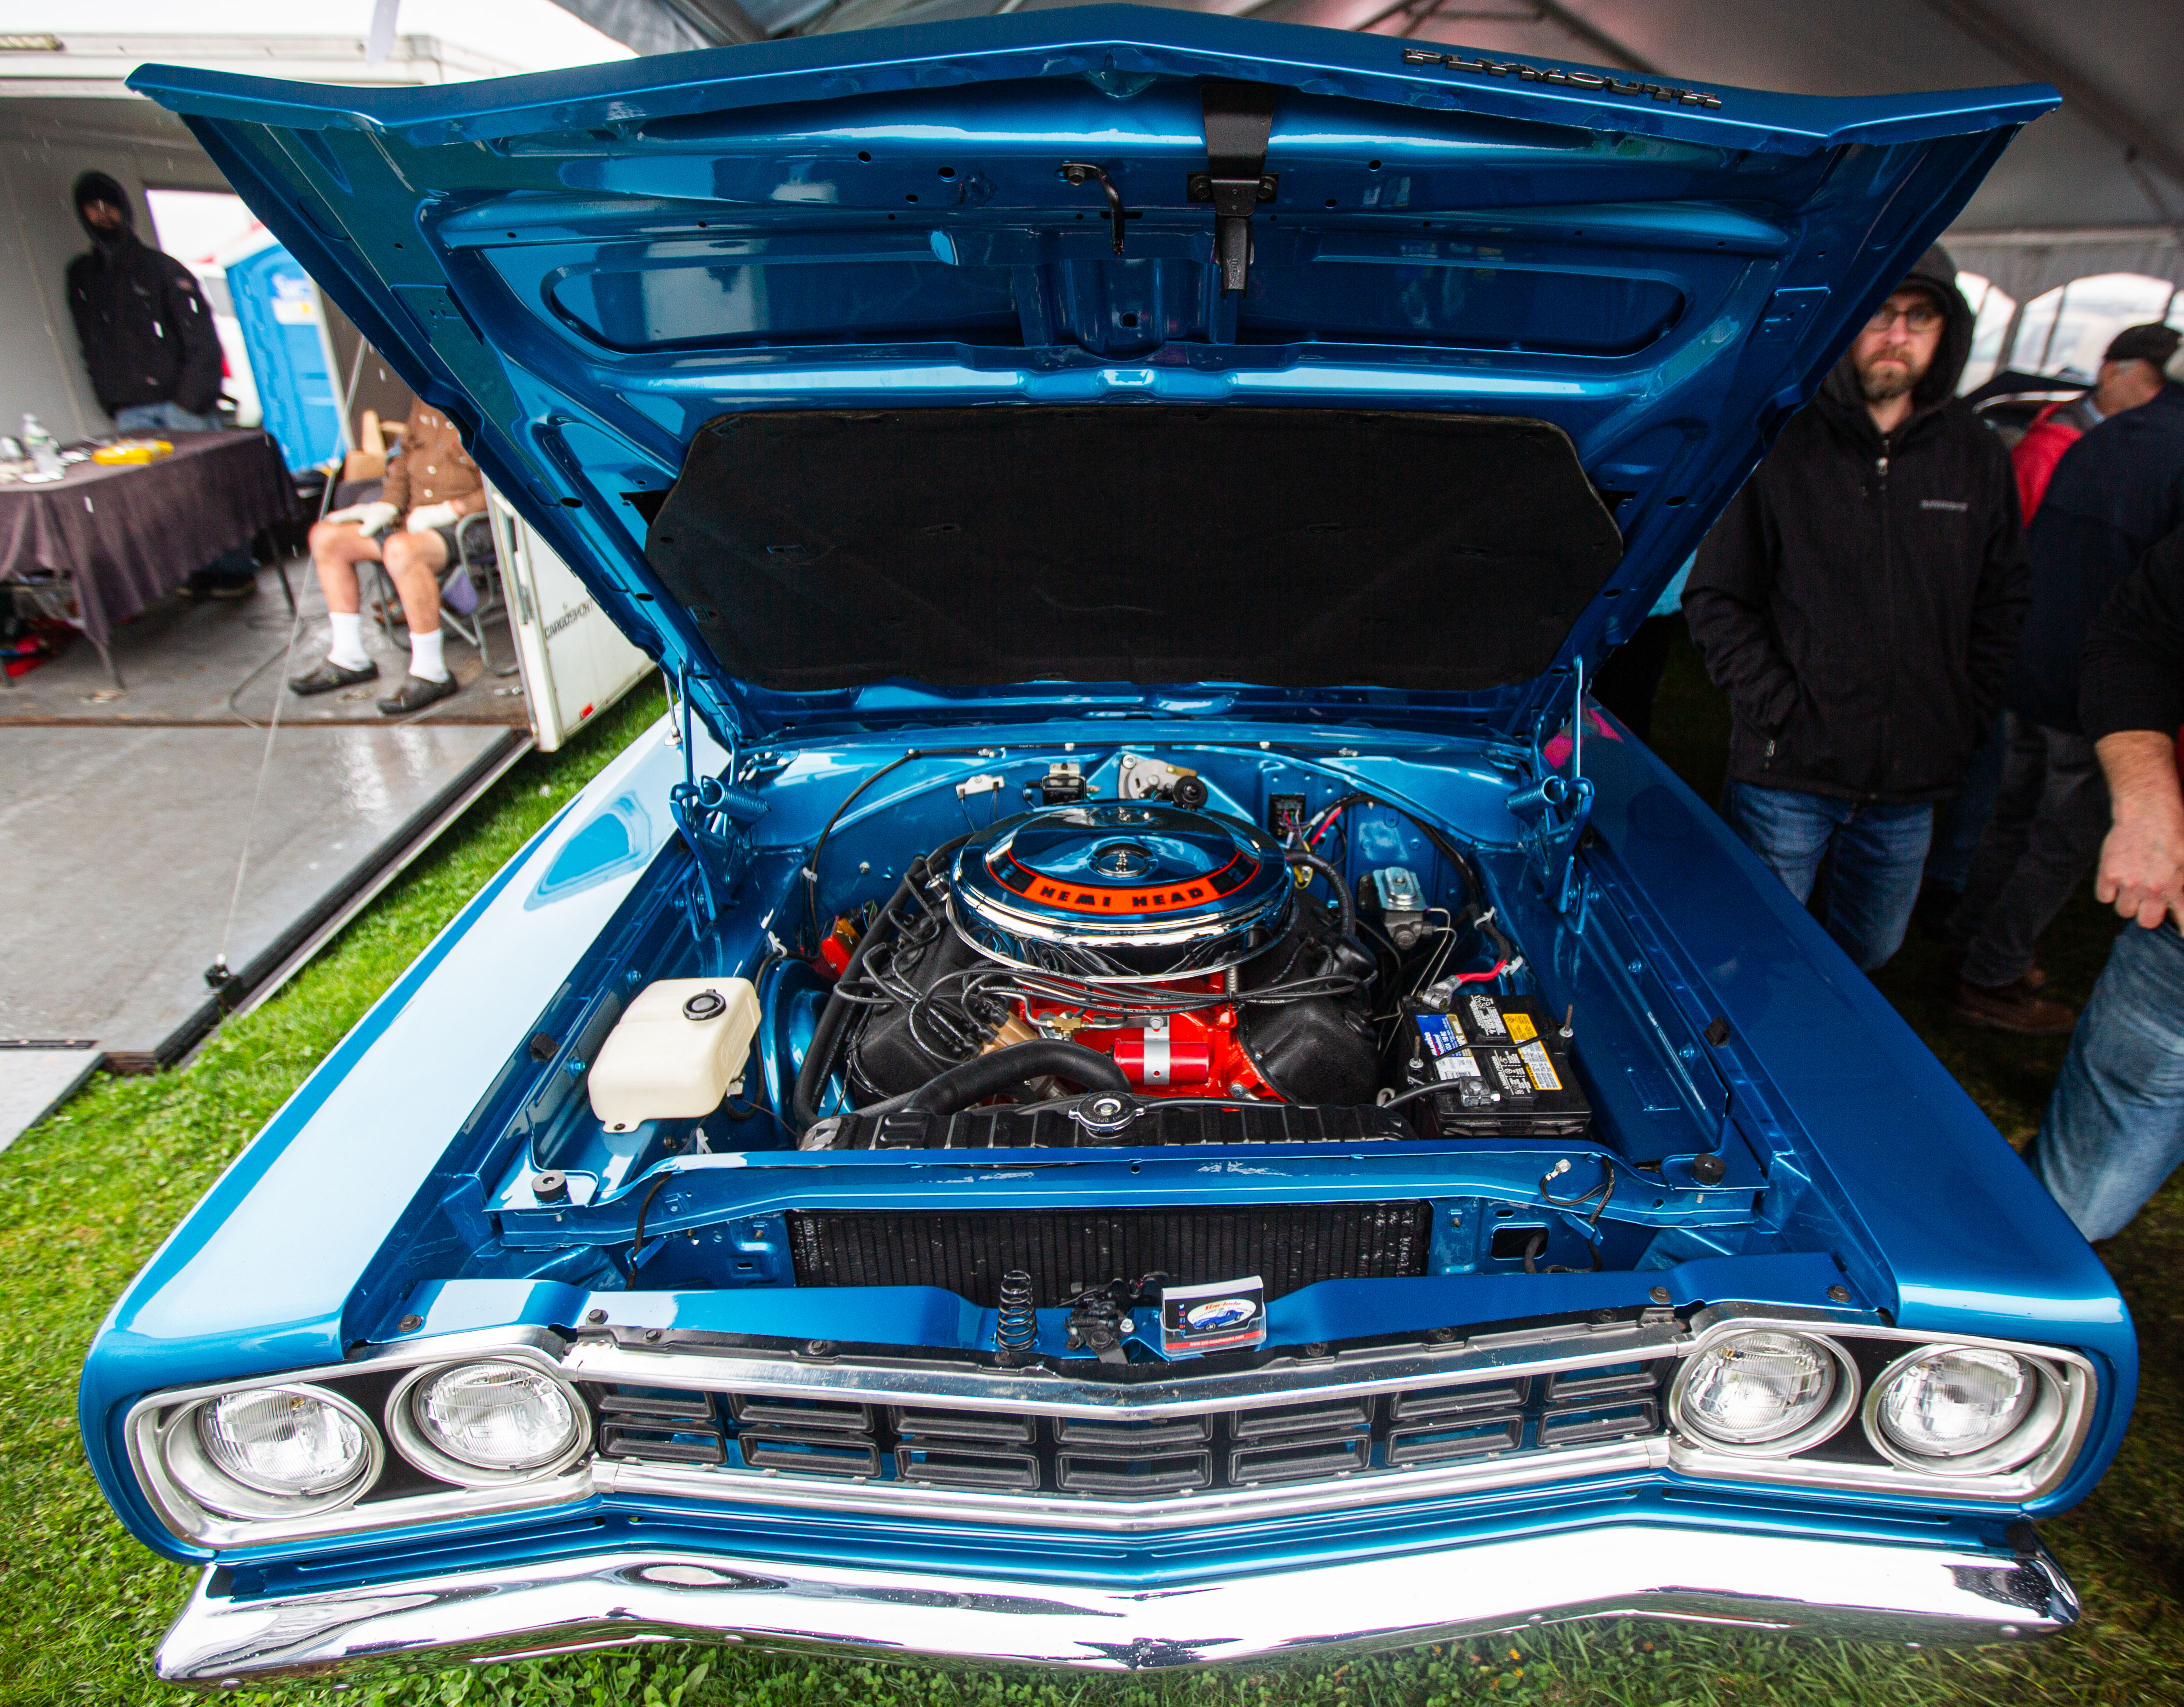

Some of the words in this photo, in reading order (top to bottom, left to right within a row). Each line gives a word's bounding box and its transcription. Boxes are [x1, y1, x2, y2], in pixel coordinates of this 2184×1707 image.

[1402, 48, 1722, 109] PLYMOUTH
[1040, 885, 1111, 907] HEMI
[1132, 888, 1205, 907] HEAD
